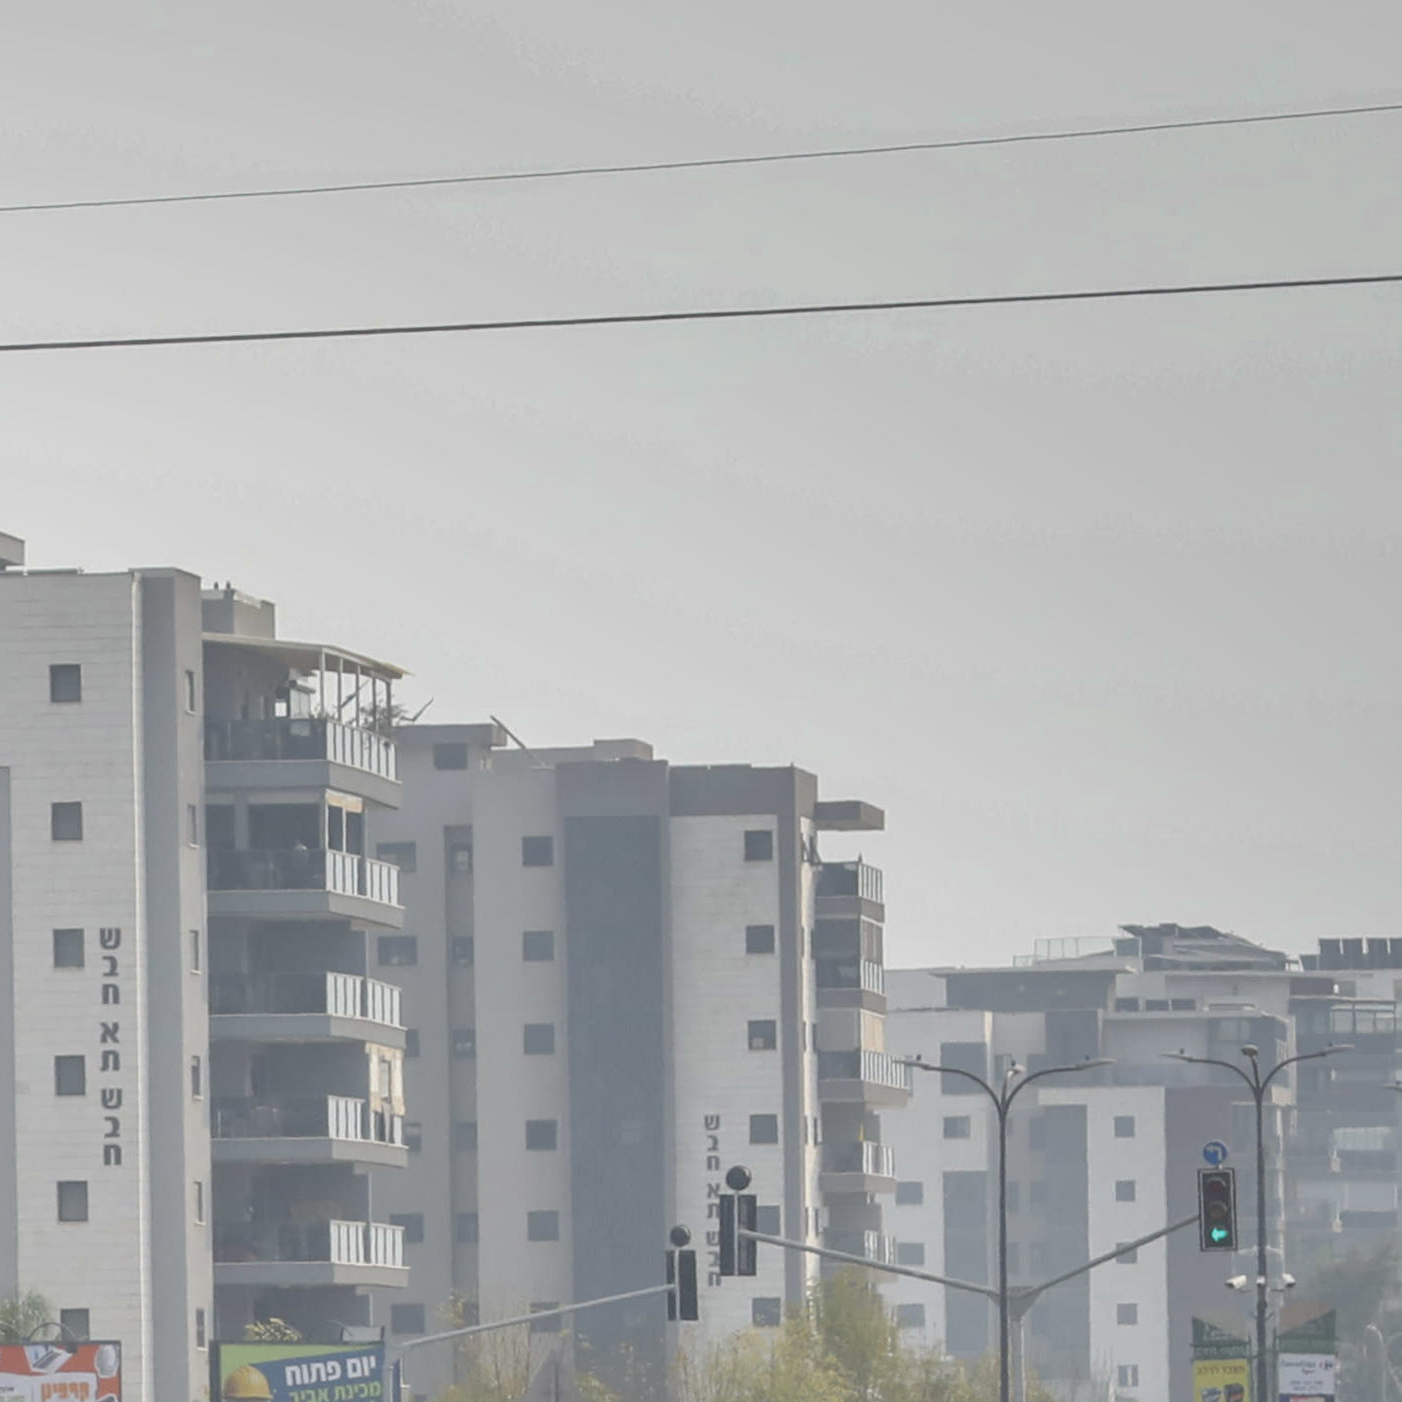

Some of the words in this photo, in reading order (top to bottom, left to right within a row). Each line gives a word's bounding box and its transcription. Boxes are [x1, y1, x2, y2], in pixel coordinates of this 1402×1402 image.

[99, 927, 122, 1005] שבח
[99, 1021, 121, 1072] את
[100, 1087, 123, 1166] שבח
[285, 1360, 342, 1387] פתוח
[346, 1355, 377, 1379] יום
[333, 1381, 381, 1402] מכינת
